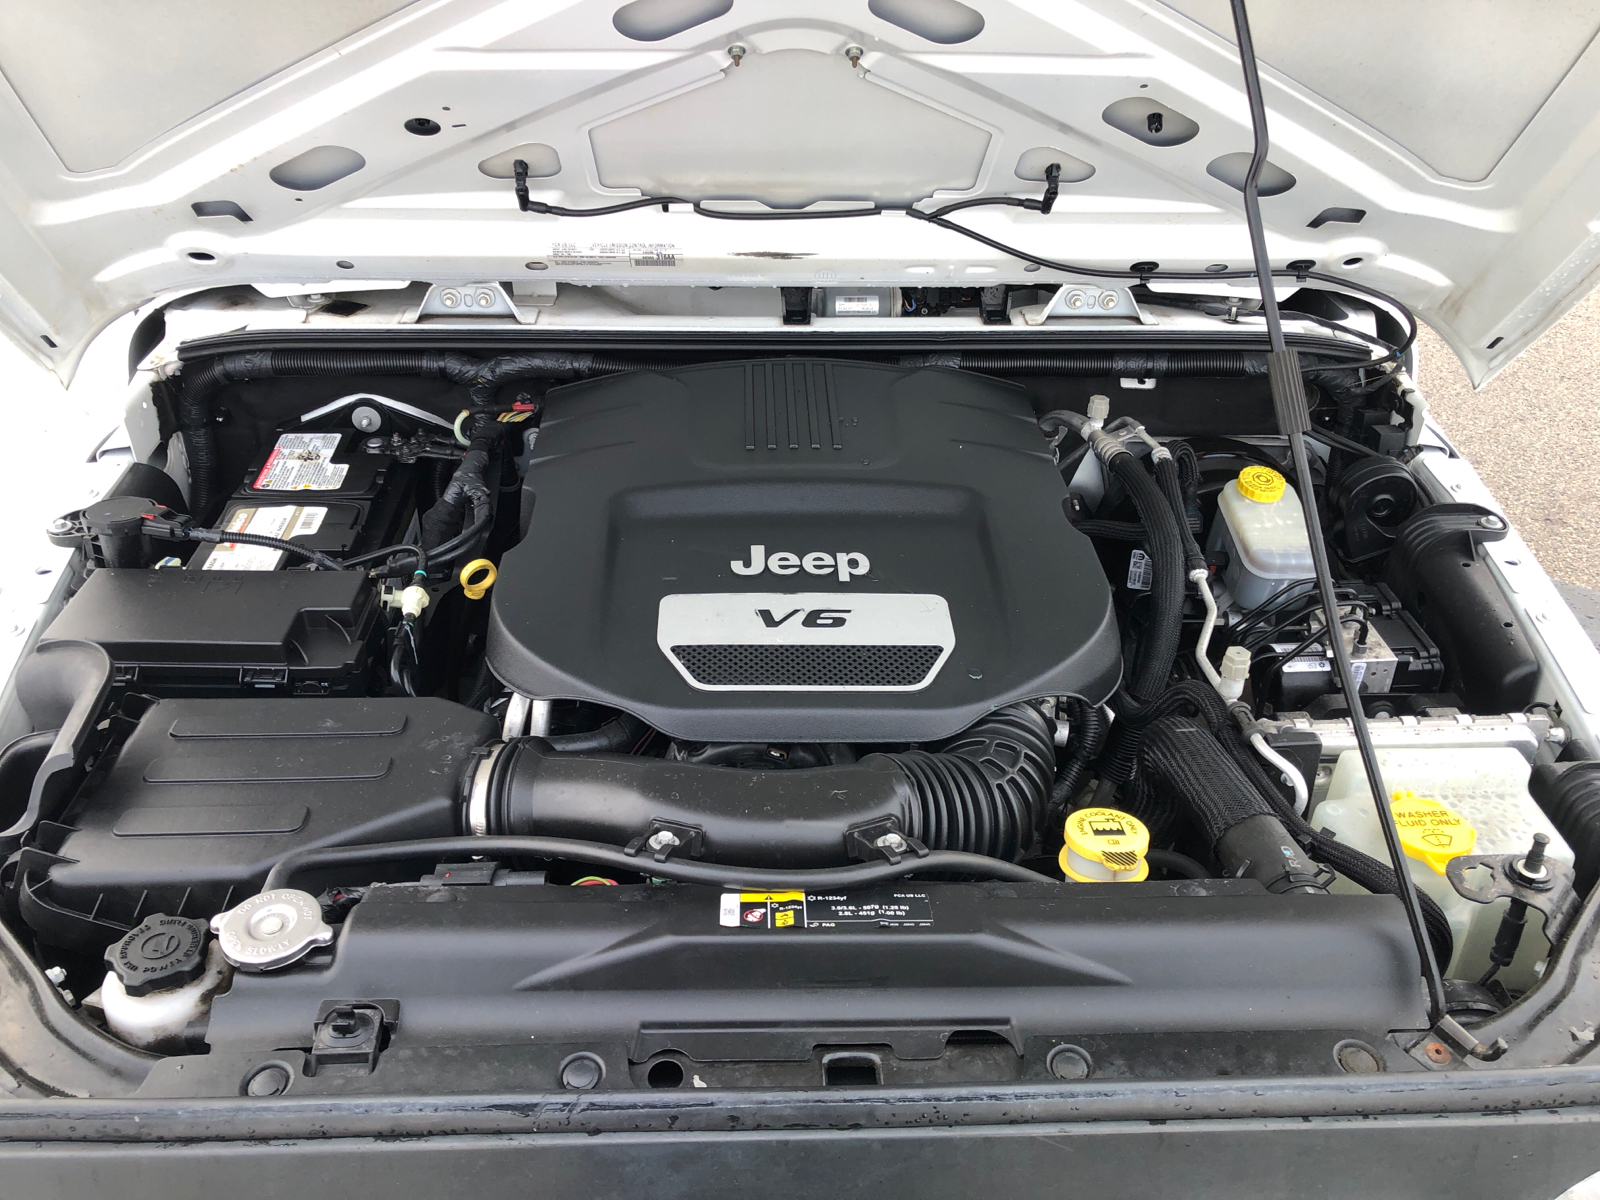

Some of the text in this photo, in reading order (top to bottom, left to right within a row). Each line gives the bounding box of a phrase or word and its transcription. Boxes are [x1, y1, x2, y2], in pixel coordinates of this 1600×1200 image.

[730, 544, 870, 582] Jeep
[756, 608, 853, 628] V6
[1085, 811, 1126, 820] COOLANT
[1126, 820, 1138, 835] ONLY
[1395, 810, 1449, 819] WASHER
[1430, 818, 1461, 826] ONLY
[237, 904, 252, 915] DO
[255, 893, 276, 904] NOT
[282, 893, 304, 906] OPEN
[226, 931, 290, 956] OPEN SLOWLY
